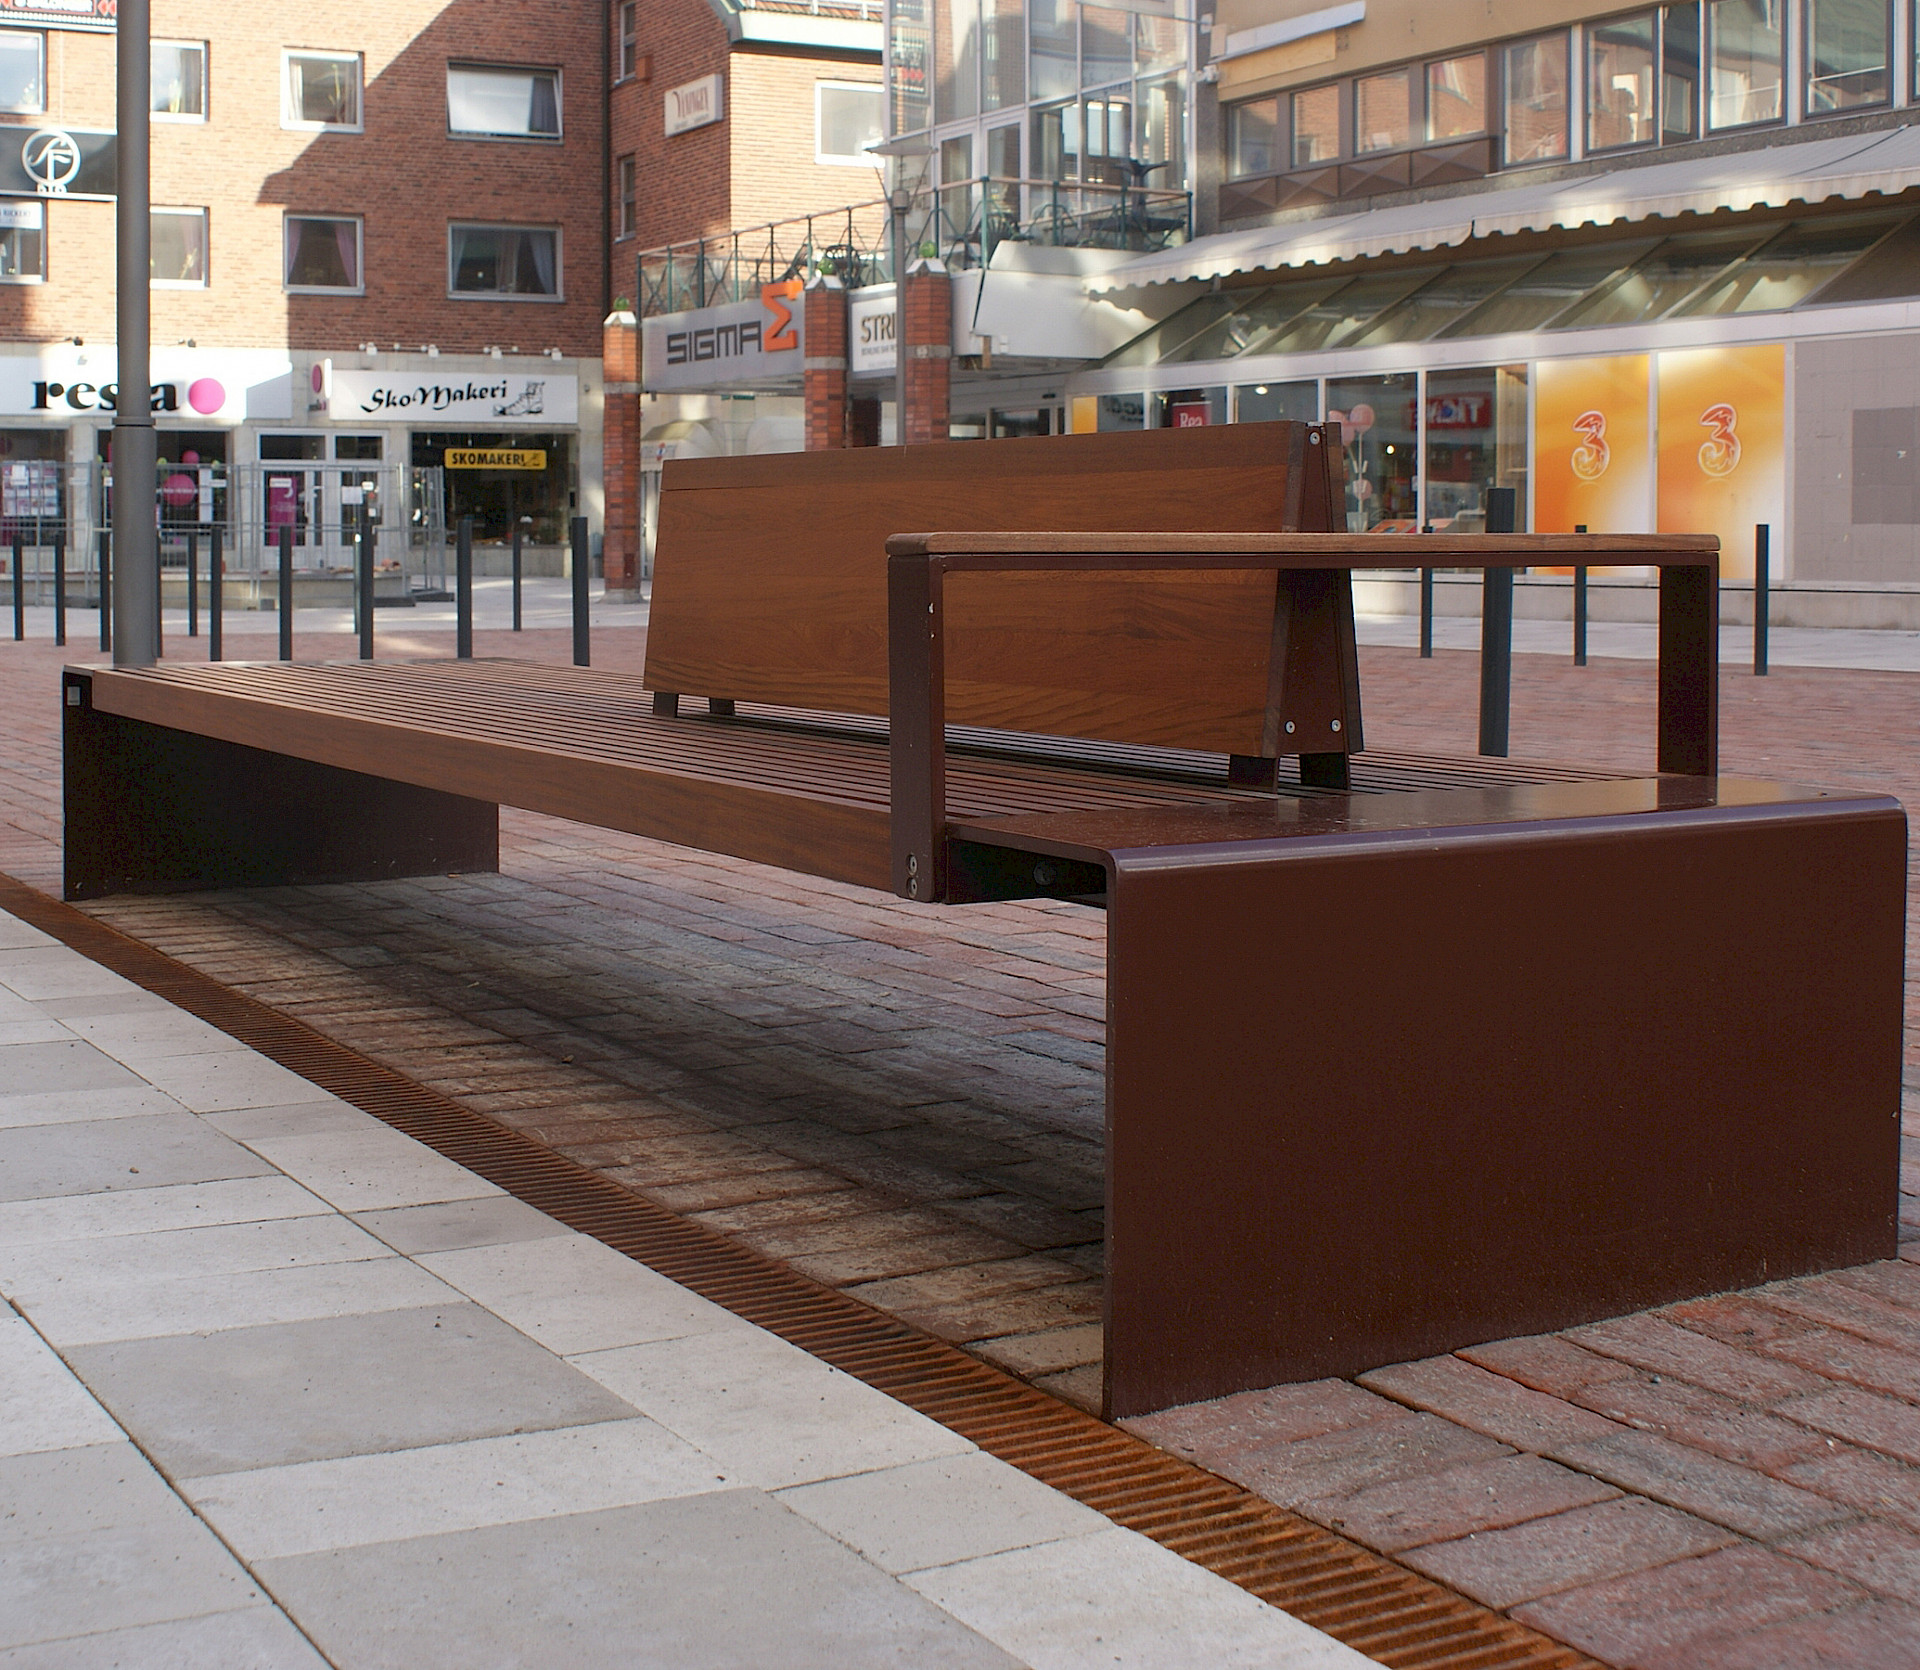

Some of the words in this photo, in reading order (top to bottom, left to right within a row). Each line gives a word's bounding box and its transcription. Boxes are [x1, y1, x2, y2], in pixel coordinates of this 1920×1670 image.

[667, 320, 762, 365] SIGMA
[861, 312, 897, 343] STRI
[31, 381, 180, 411] resa
